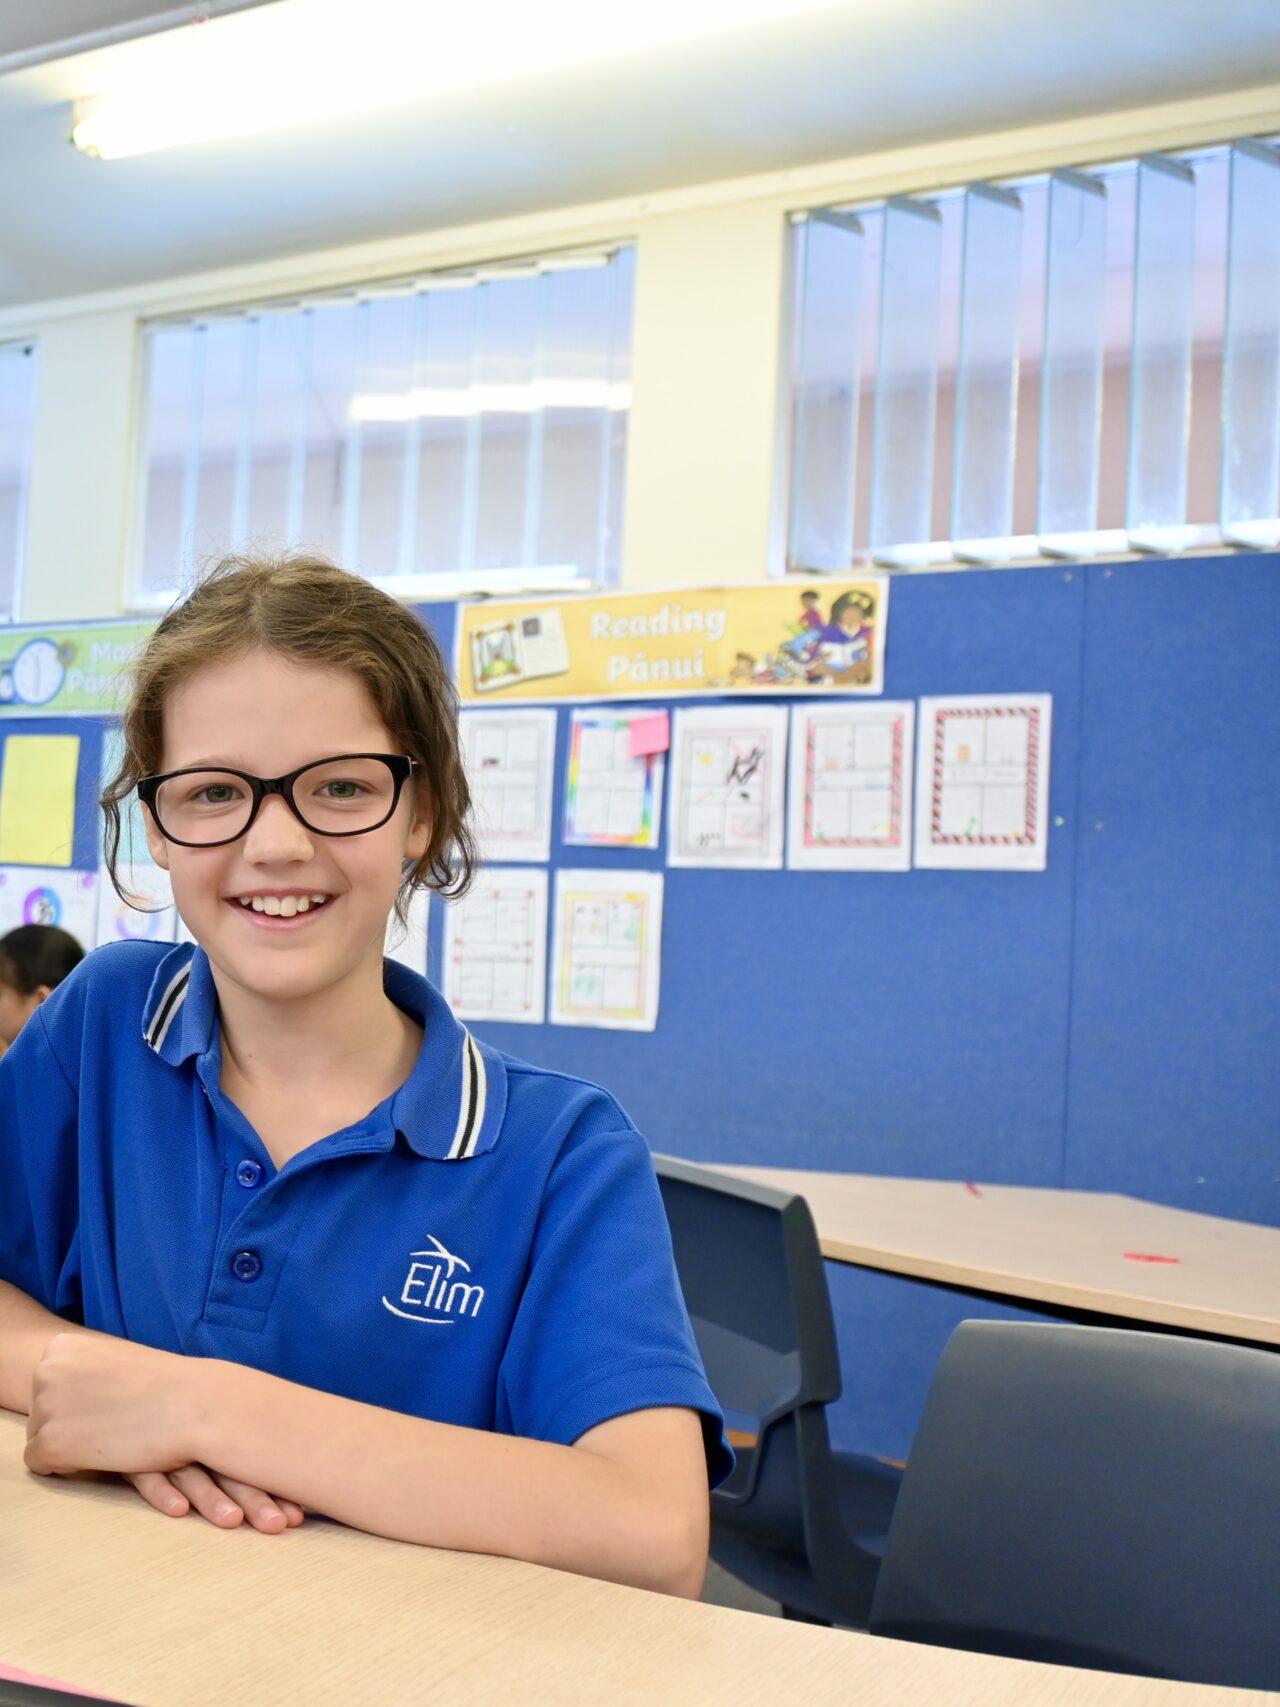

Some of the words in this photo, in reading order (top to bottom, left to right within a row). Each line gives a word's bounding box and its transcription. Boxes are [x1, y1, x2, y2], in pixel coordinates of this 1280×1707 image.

[591, 602, 728, 641] Reading
[607, 649, 705, 683] Pānui
[401, 1263, 485, 1317] Elim
